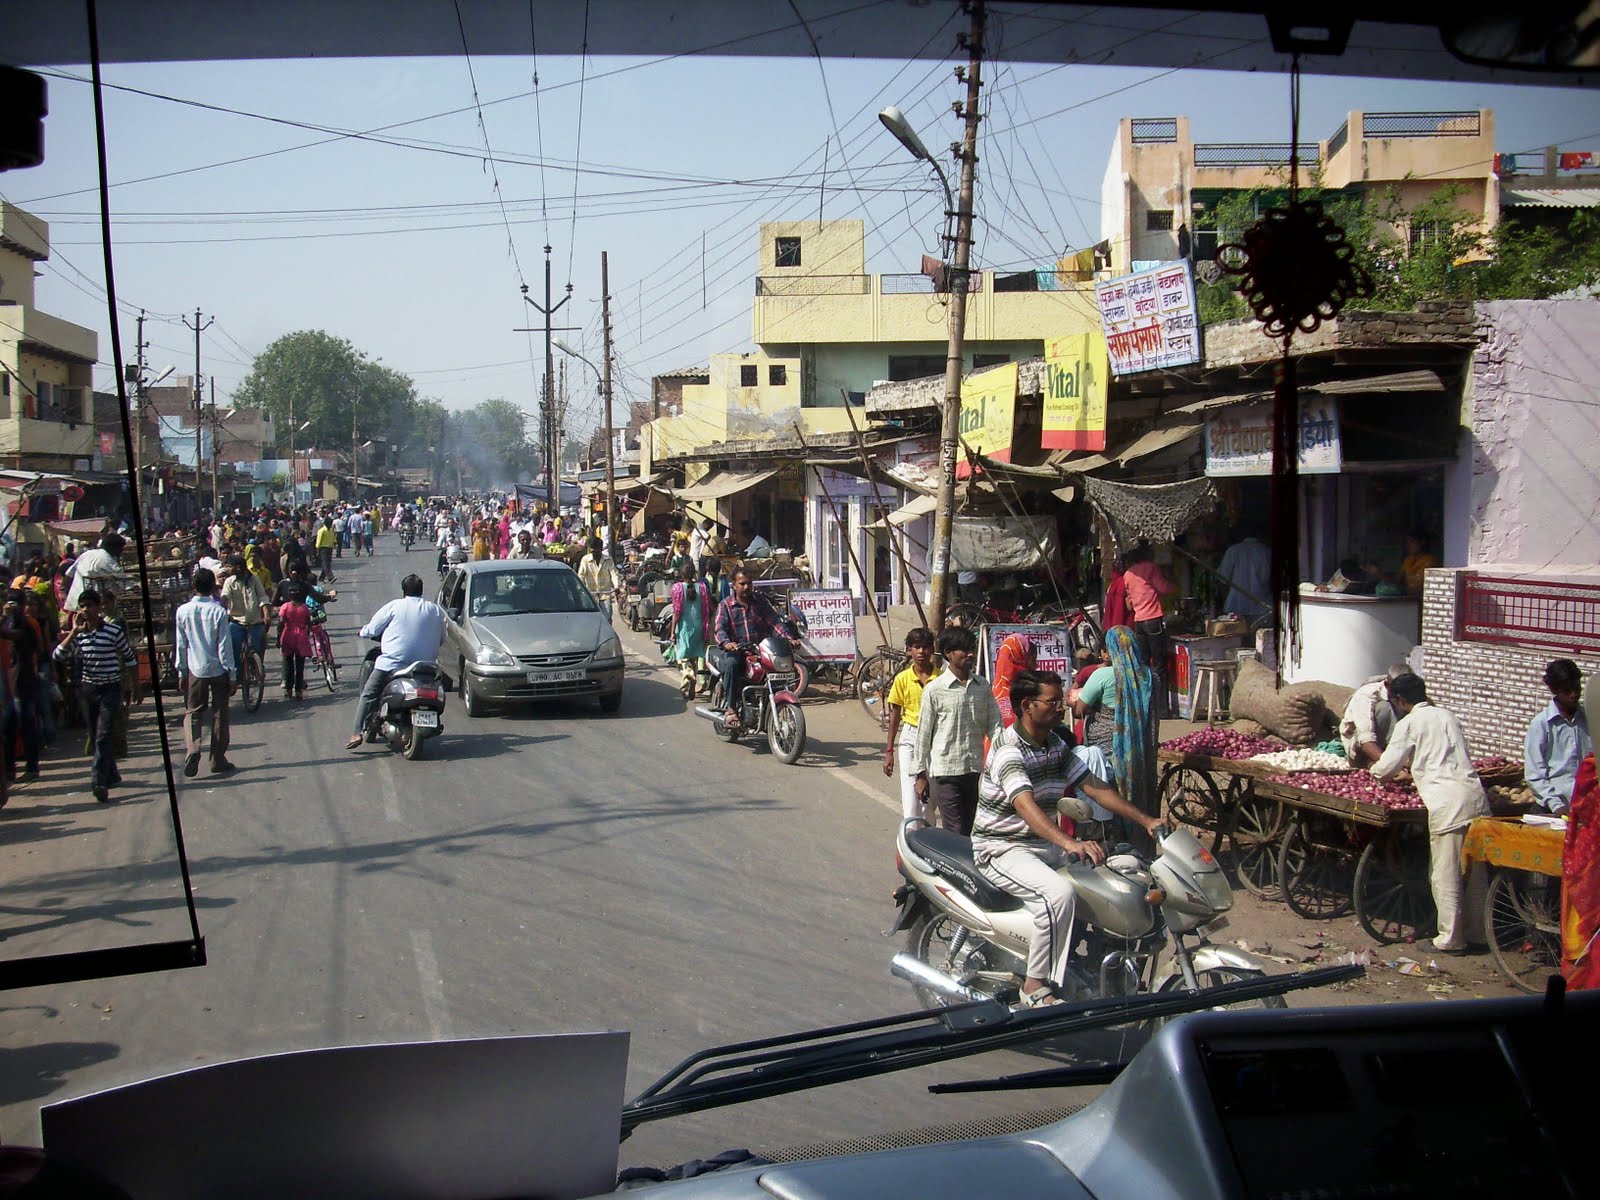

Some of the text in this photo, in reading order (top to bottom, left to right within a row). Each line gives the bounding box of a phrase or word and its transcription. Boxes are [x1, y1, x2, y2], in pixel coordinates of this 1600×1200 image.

[1047, 360, 1080, 399] Vital
[959, 396, 986, 434] ital
[819, 596, 851, 609] पंसारी
[807, 611, 824, 627] जड़ी
[952, 869, 979, 895] FREEDOM
[1008, 930, 1028, 944] LML
